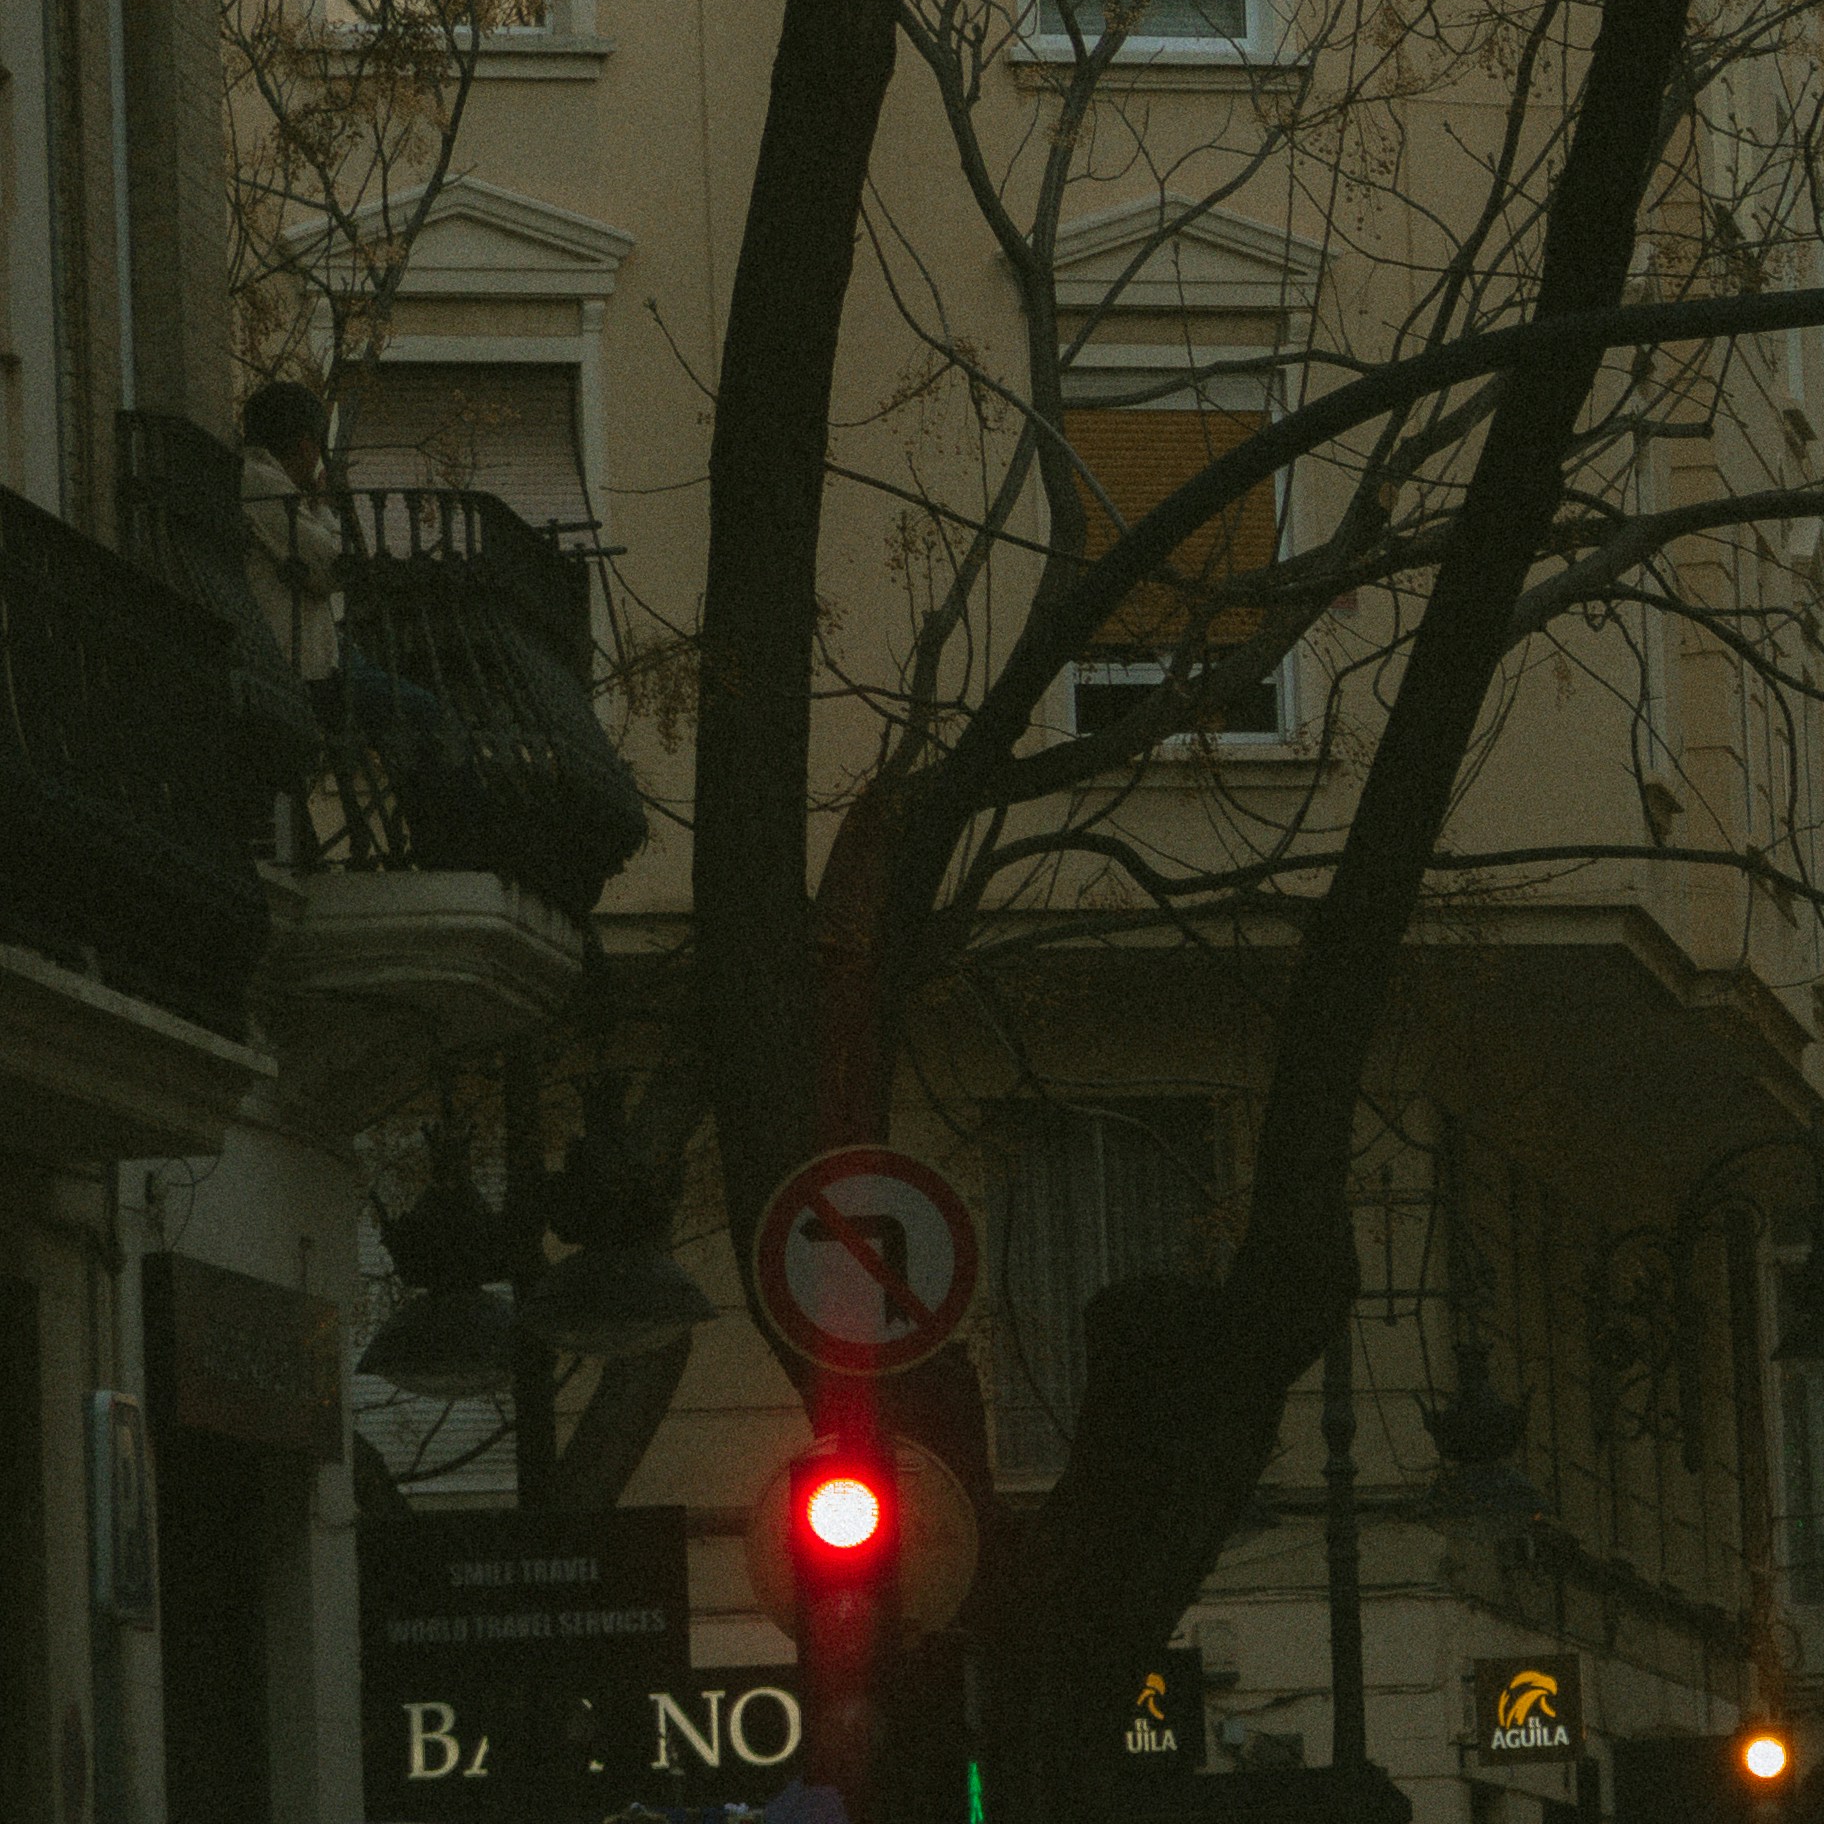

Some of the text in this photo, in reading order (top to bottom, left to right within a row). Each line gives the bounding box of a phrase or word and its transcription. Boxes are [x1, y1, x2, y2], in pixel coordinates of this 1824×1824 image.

[520, 1557, 600, 1584] TRAVEL
[385, 1608, 668, 1643] WORLD TRAVEL SERVICES
[1125, 1727, 1178, 1754] UILA
